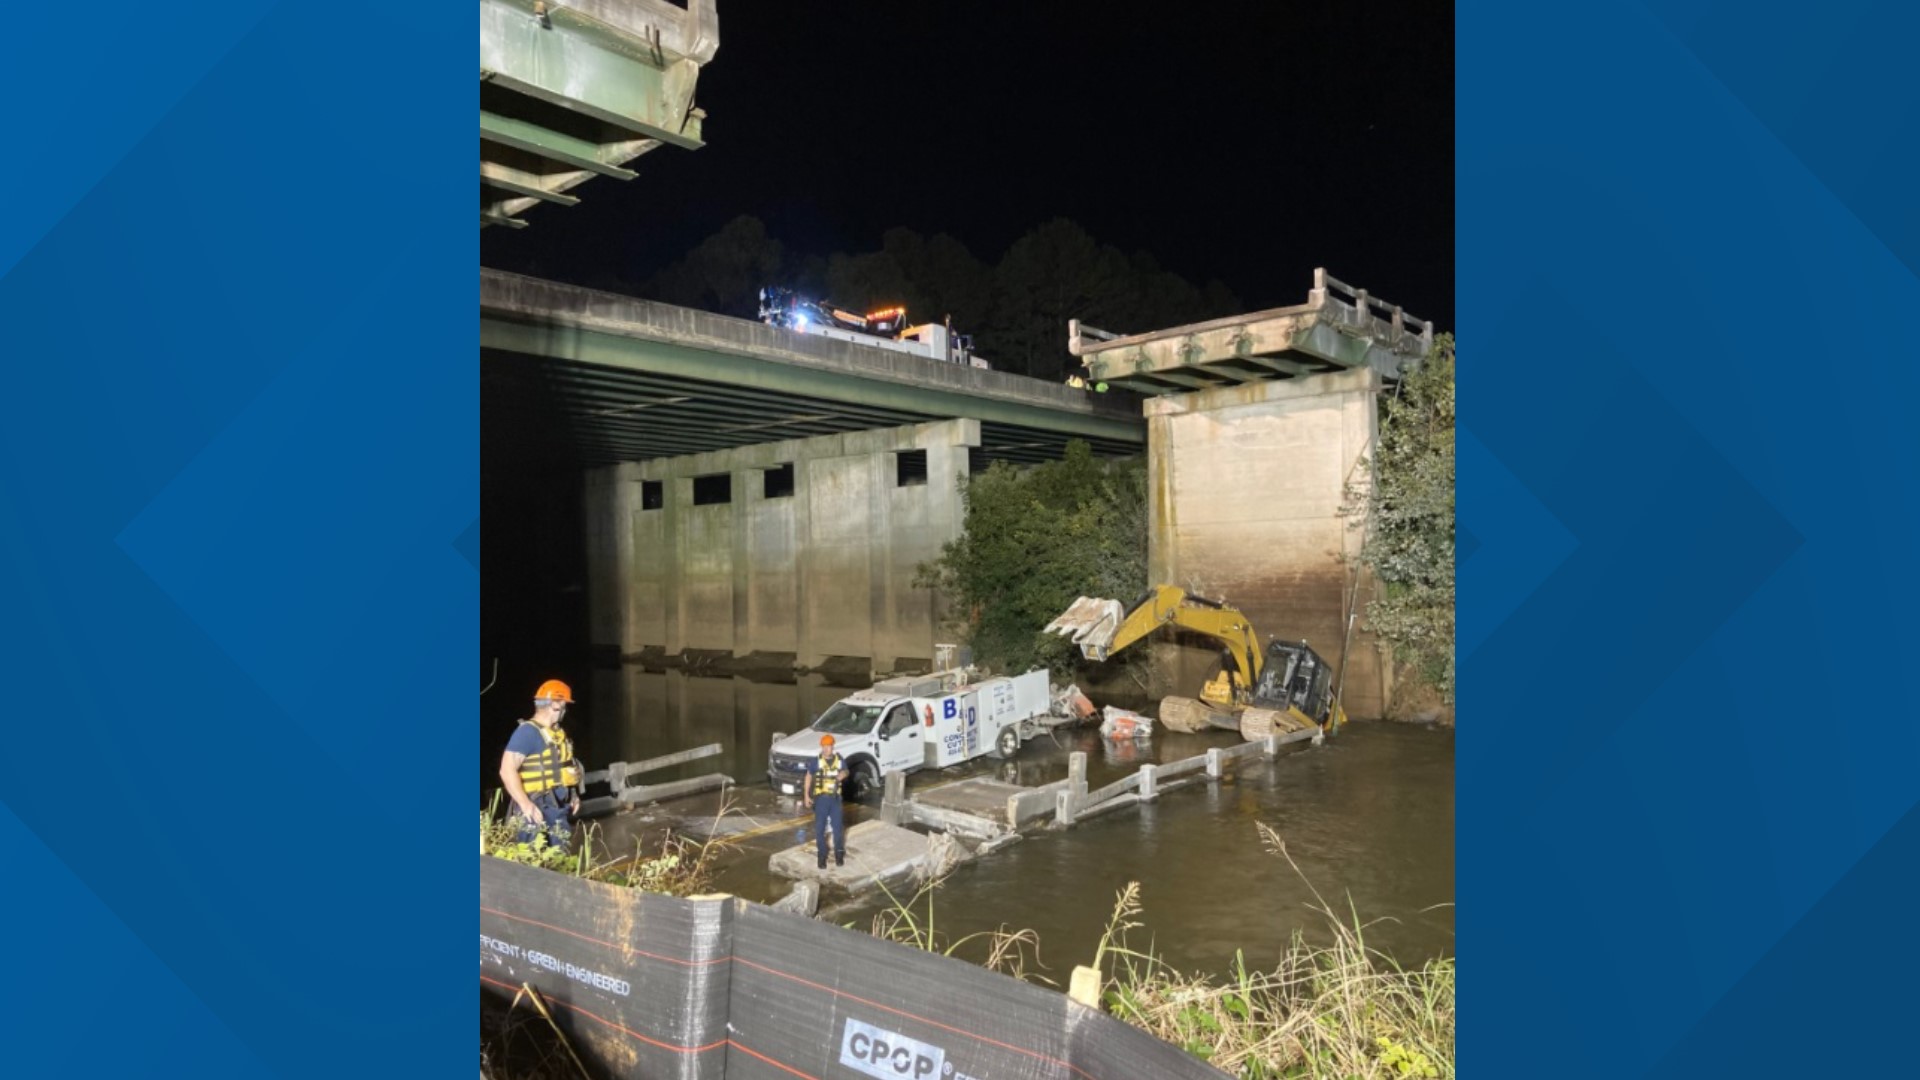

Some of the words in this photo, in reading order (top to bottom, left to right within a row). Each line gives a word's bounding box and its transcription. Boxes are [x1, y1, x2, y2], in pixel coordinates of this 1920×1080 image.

[943, 698, 957, 719] B
[968, 706, 976, 726] D
[528, 949, 560, 973] GREEN
[566, 963, 630, 996] ENGINEERED
[849, 1032, 934, 1079] CPOP
